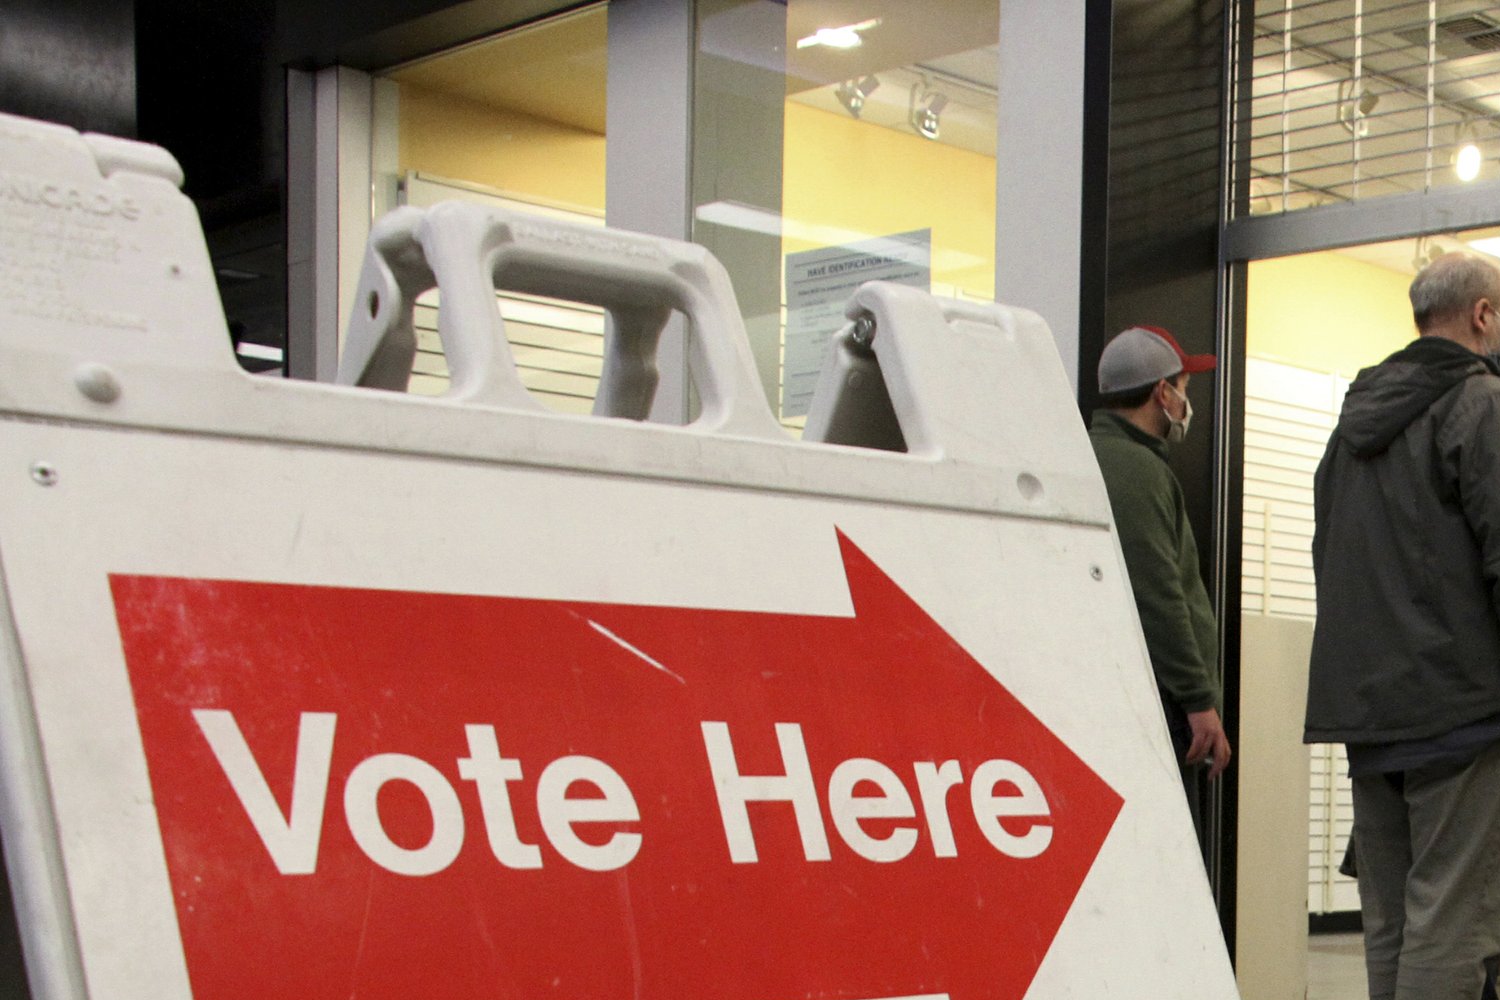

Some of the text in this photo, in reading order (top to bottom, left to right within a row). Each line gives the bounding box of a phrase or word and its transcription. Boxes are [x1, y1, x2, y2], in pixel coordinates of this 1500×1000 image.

[807, 265, 826, 278] HAVE
[828, 256, 882, 274] IDENTIFICATION
[190, 708, 1055, 877] Vote Here
